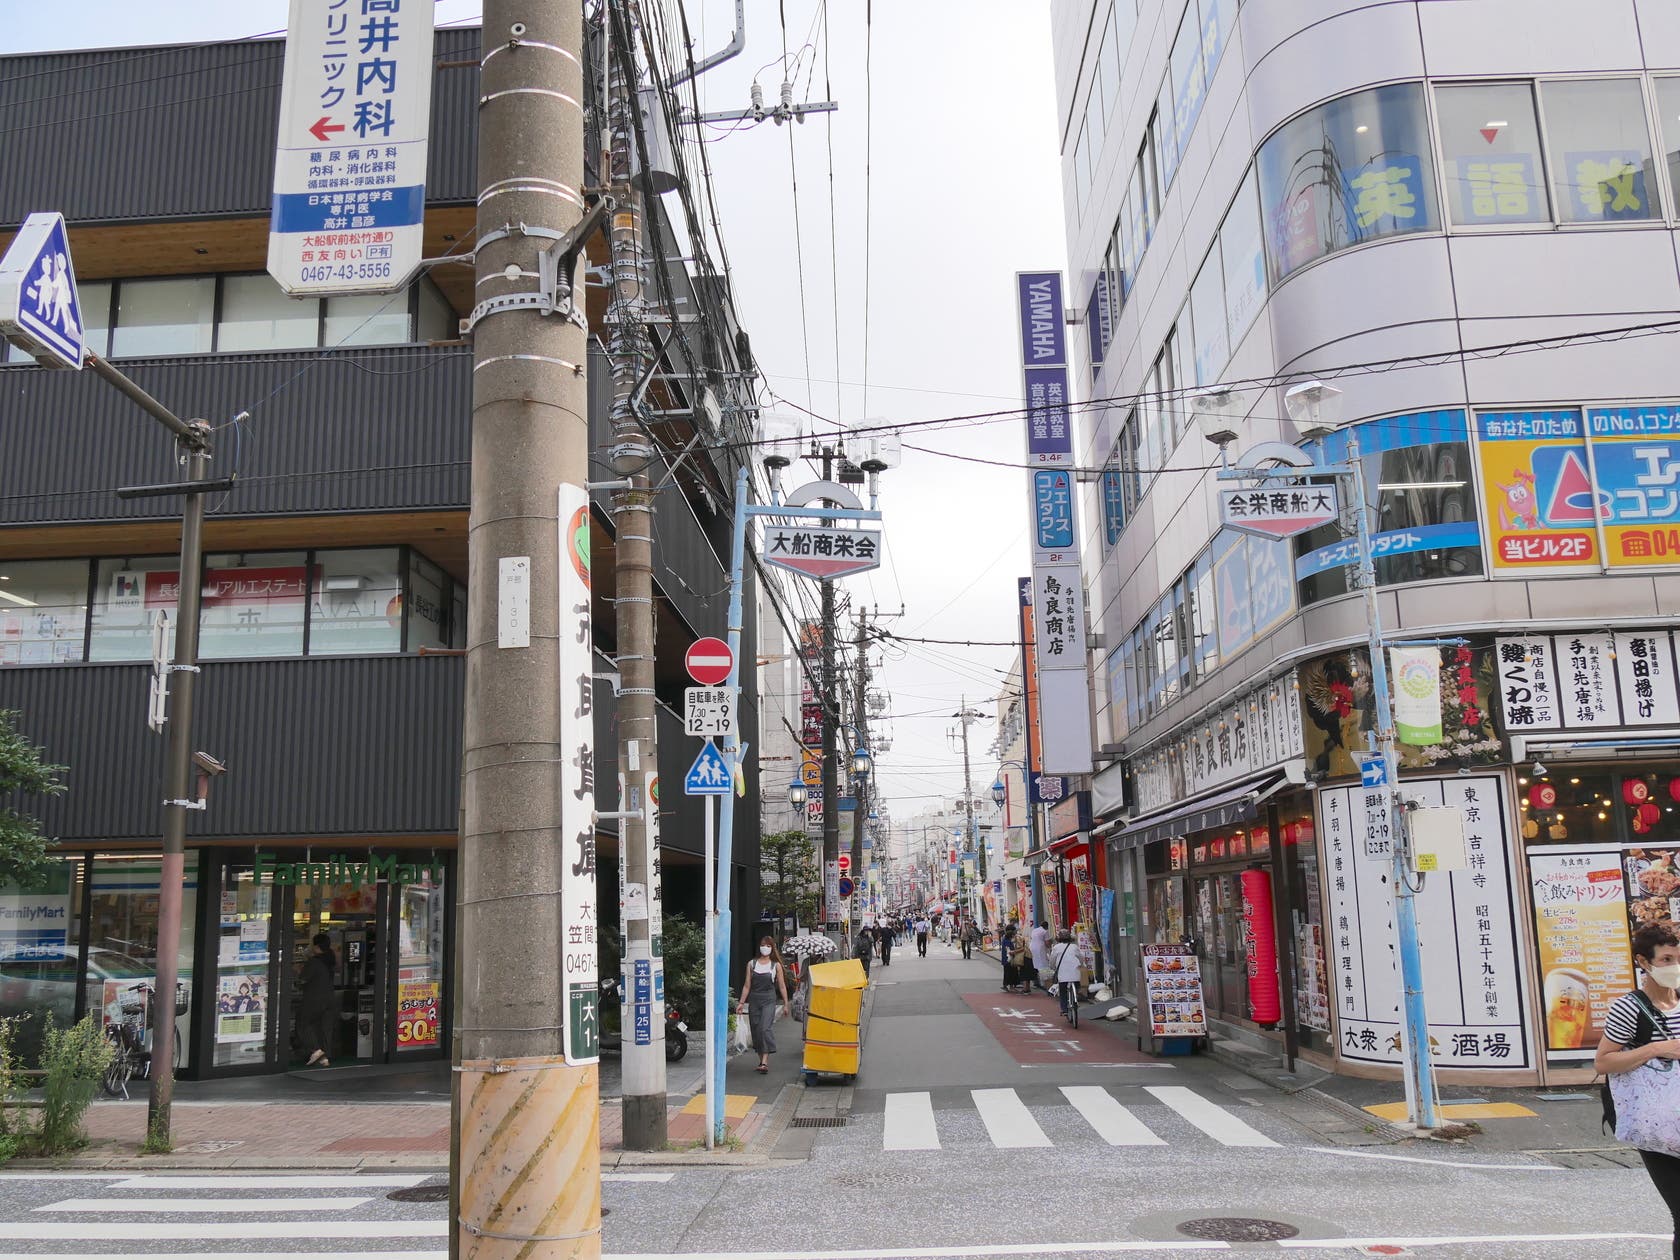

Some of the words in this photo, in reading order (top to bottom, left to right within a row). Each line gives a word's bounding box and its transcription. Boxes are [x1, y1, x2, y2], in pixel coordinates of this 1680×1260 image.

[320, 0, 349, 109] リニック
[309, 147, 398, 163] 糖尿病内科
[308, 160, 397, 177] 内科・消化器科
[307, 174, 396, 190] 循環器科・呼吸器科
[308, 191, 393, 206] 日本糖尿病学会
[1351, 166, 1416, 228] 英
[1467, 163, 1529, 216] 語
[330, 204, 369, 215] 専門医
[323, 217, 347, 229] 高井
[351, 215, 376, 228] 昌彦
[302, 231, 394, 247] 大船駅前松竹通り
[301, 249, 362, 262] 西友向い
[300, 262, 391, 283] 0467-43-5556
[1028, 279, 1055, 360] YAMAHA
[1486, 418, 1578, 437] あなたのため
[1039, 453, 1062, 462] 3.4F
[1038, 475, 1055, 544] コンタクト
[1054, 491, 1070, 532] エース
[770, 531, 877, 559] 大船商栄会
[1504, 538, 1586, 559] 当ビル2F
[1050, 553, 1063, 562] 2F
[159, 577, 307, 598] 長谷リアルエステート
[1044, 575, 1064, 656] 鳥良商店
[1529, 644, 1552, 722] 商店自慢の一品
[1569, 638, 1595, 721] 手羽先唐揚
[689, 691, 730, 704] 自転車を除く
[689, 719, 730, 732] 12-19
[808, 803, 825, 813] DV
[1463, 786, 1481, 823] 東京
[1367, 824, 1389, 839] 12-19
[1369, 841, 1390, 854] ここまで
[253, 852, 446, 892] FamilyMart
[1468, 834, 1487, 889] 吉祥寺
[1474, 904, 1498, 1018] 昭和五十九年創業
[398, 1019, 429, 1042] 30
[637, 1016, 649, 1026] 25
[1344, 1026, 1379, 1053] 大衆
[1451, 1033, 1512, 1058] 酒場
